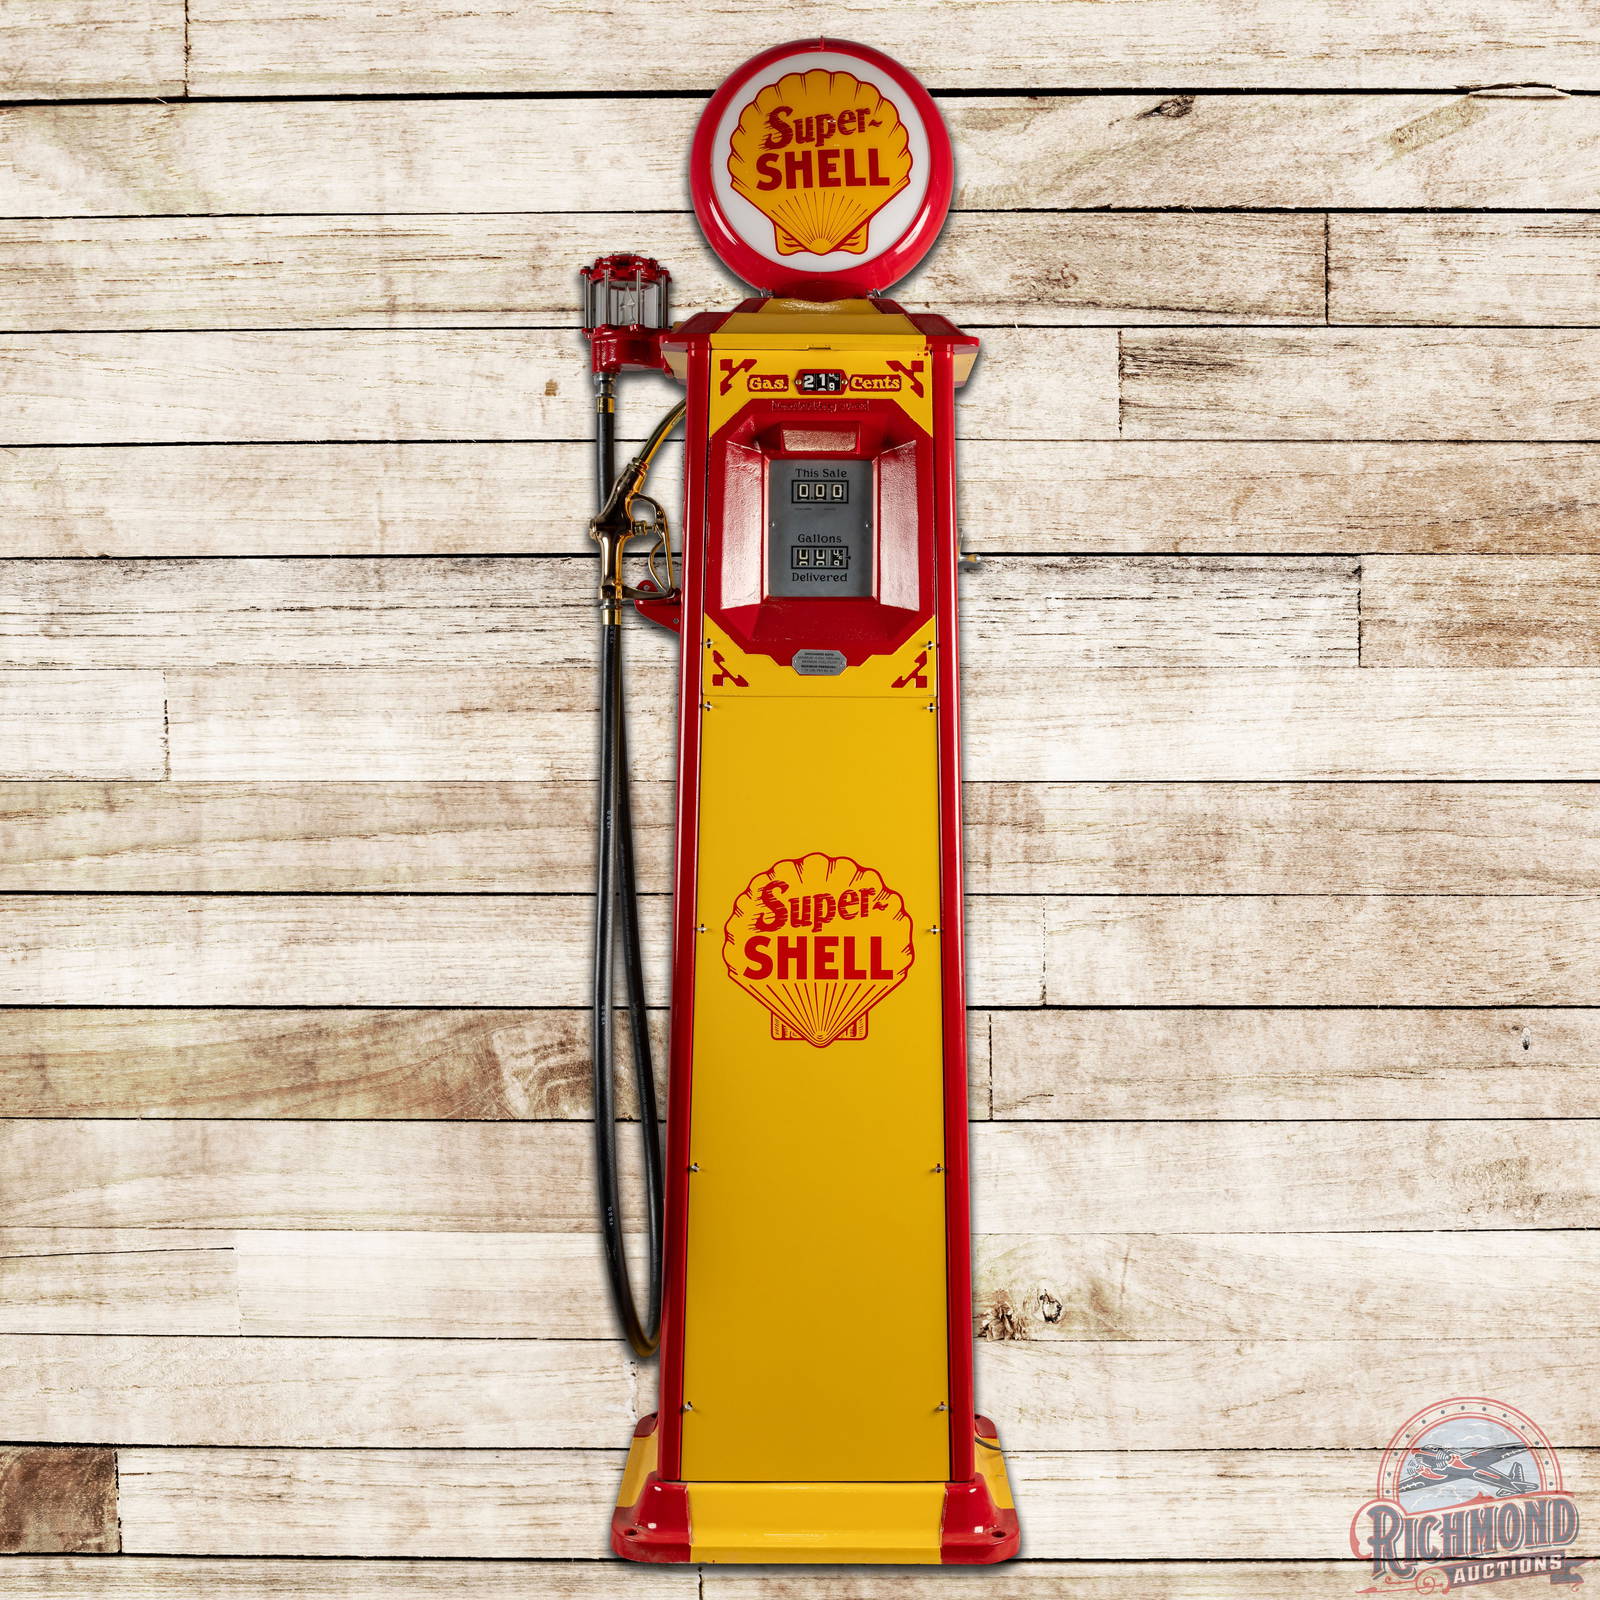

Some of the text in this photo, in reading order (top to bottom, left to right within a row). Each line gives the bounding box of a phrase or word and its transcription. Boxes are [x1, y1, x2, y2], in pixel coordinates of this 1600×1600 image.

[756, 148, 890, 191] SHELL
[850, 376, 900, 390] Cents
[795, 468, 848, 478] This Sale
[797, 533, 842, 544] Gallons
[792, 573, 848, 583] Delivered
[743, 935, 894, 981] SHELL
